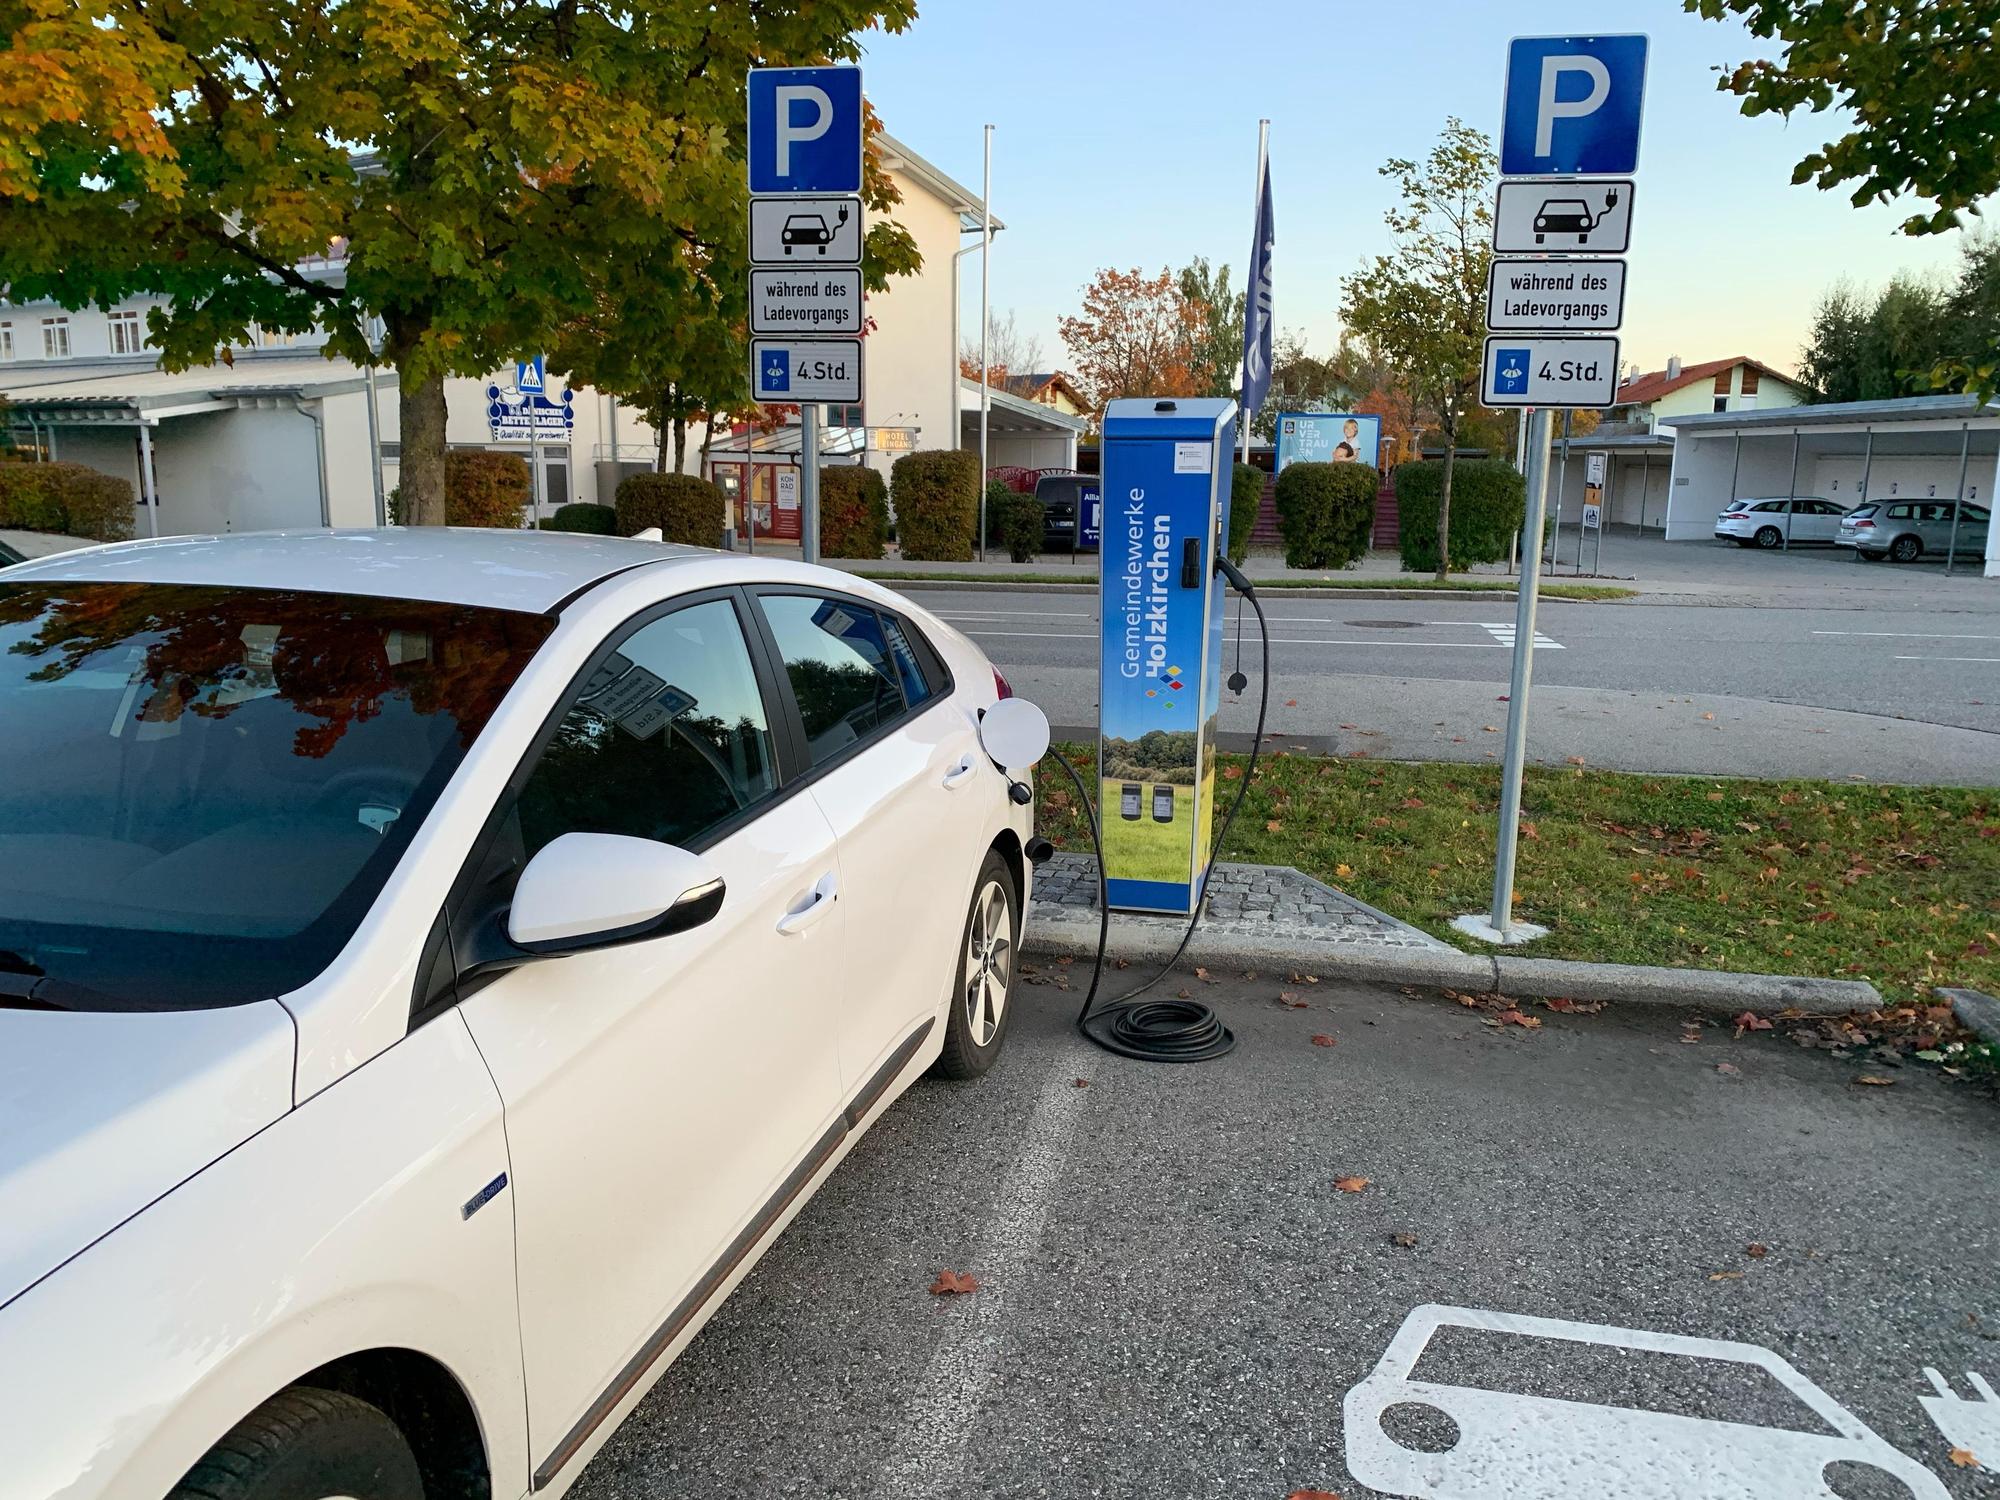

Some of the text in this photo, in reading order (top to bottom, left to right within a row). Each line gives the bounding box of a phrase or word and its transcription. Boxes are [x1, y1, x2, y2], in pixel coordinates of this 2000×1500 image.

[1535, 55, 1611, 157] P
[775, 85, 834, 177] P
[766, 281, 847, 297] während des
[1510, 274, 1607, 291] während des
[763, 305, 849, 324] Ladevorgangs
[1504, 299, 1608, 320] Ladevorgangs
[797, 361, 850, 381] 4.Std.
[1538, 361, 1603, 382] 4.Std.
[772, 378, 779, 389] P
[1507, 380, 1515, 390] P
[522, 406, 563, 416] DNISCHES
[501, 416, 564, 426] BETTELAGER
[1300, 420, 1314, 429] UR
[886, 432, 909, 440] HOTEL
[1299, 430, 1320, 439] VER
[1299, 439, 1328, 448] TRAU
[1121, 487, 1145, 678] Gemeindewerke
[1145, 514, 1171, 678] Holzkirchen
